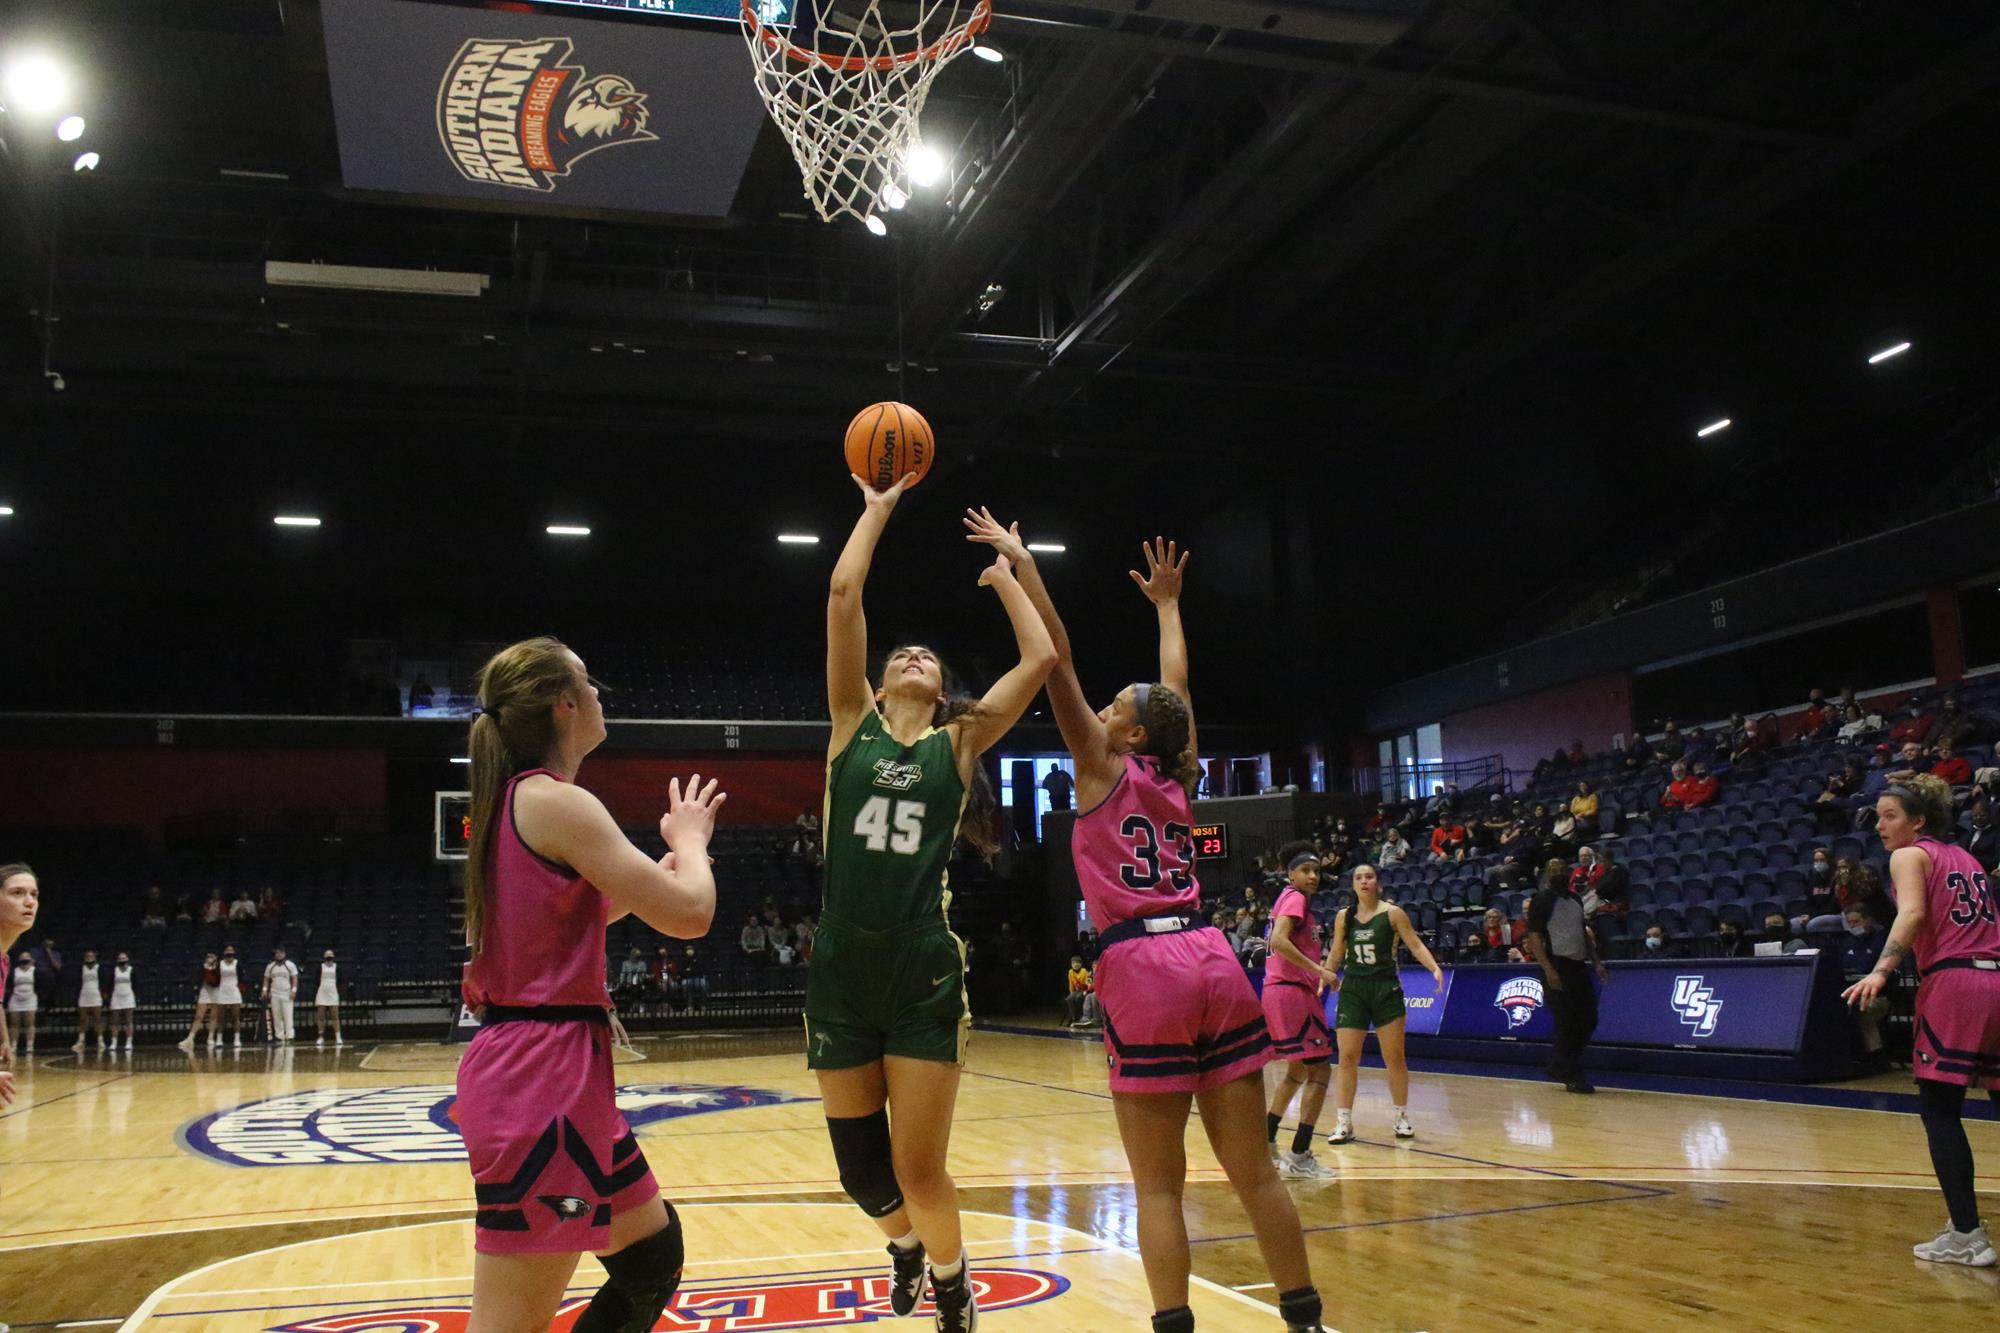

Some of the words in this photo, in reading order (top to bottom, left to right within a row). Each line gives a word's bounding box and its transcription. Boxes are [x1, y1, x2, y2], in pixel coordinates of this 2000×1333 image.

[446, 43, 508, 182] SOUTHERN
[479, 43, 555, 187] INDIANA
[531, 76, 559, 111] EAGLES
[525, 114, 550, 166] SCREAMING
[877, 430, 896, 486] Wilson
[724, 726, 739, 736] 201
[726, 739, 739, 748] 101
[853, 795, 926, 855] 45
[1204, 840, 1220, 853] 23
[1120, 814, 1195, 891] 33
[1354, 944, 1377, 965] 15
[1410, 997, 1434, 1008] GROUP
[1673, 978, 1720, 1031] USI
